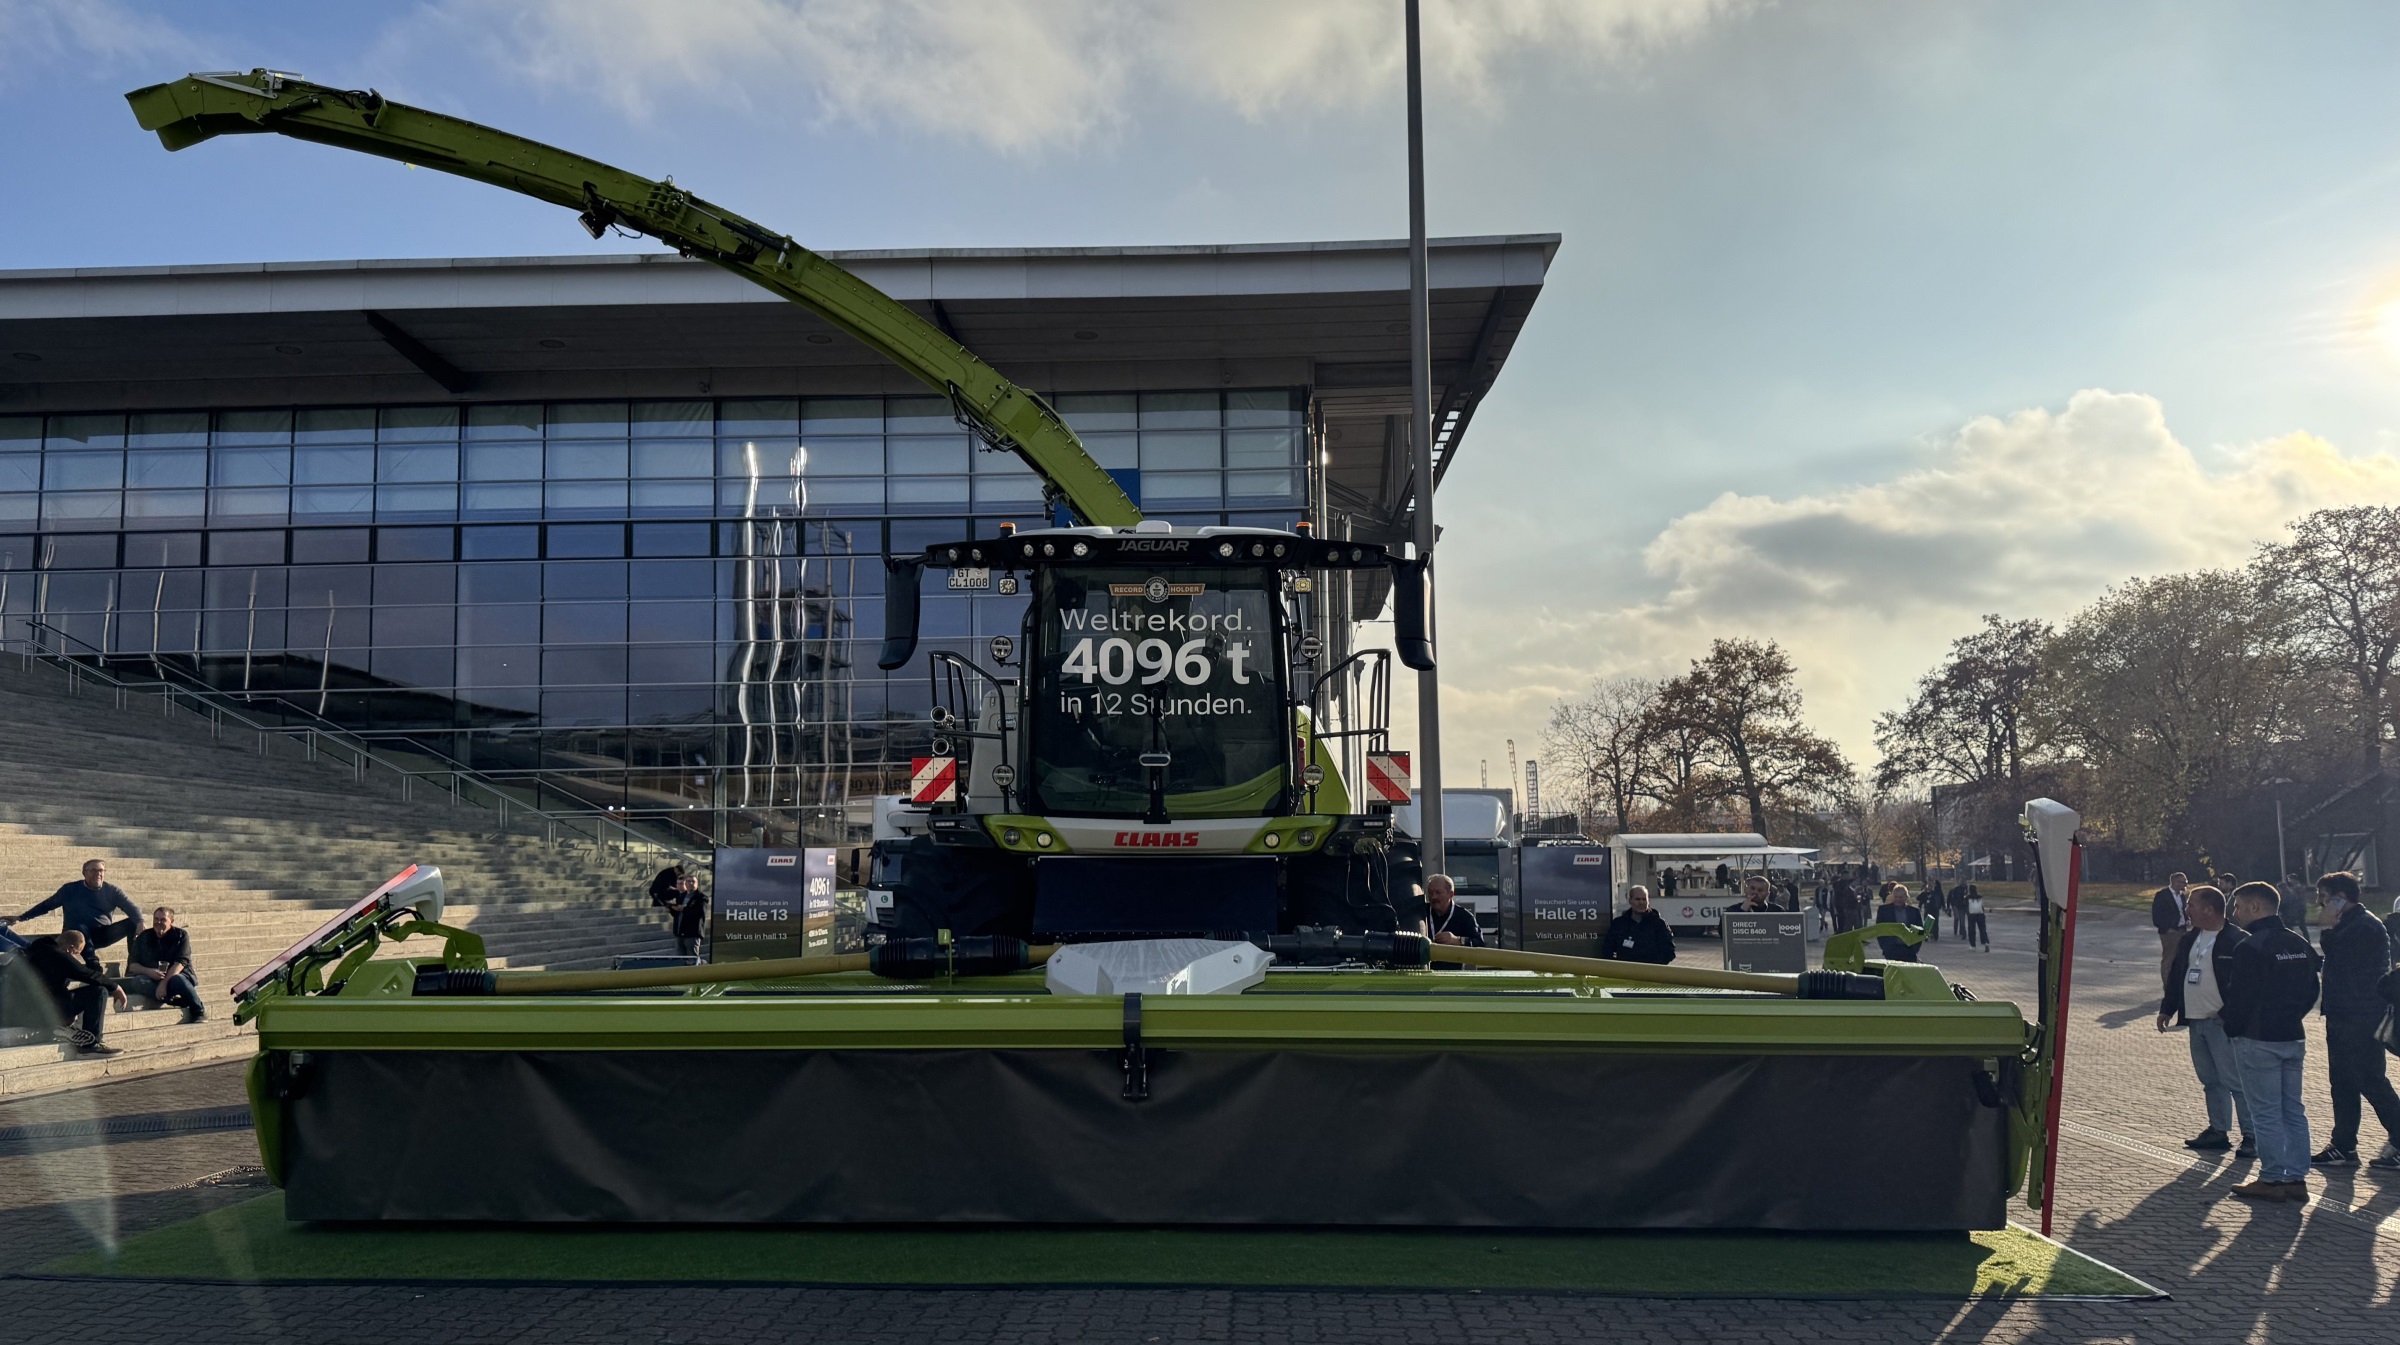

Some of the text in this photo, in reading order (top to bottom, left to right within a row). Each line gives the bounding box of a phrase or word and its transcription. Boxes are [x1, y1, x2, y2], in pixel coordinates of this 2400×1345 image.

[1117, 540, 1190, 551] JAGUAR
[957, 568, 970, 577] GT
[1060, 608, 1252, 631] Weltrekord.
[1061, 638, 1250, 685] 4096 t
[1060, 691, 1082, 714] in
[1090, 693, 1123, 715] 12
[1114, 832, 1199, 847] CLAAS
[725, 909, 788, 921] Halle 13
[1534, 907, 1598, 920] Halle 13
[725, 932, 742, 940] Visit
[762, 932, 777, 940] hall
[778, 932, 788, 940] 13
[1535, 932, 1552, 940] Visit
[1573, 932, 1587, 940] hall
[1589, 932, 1598, 940] 13
